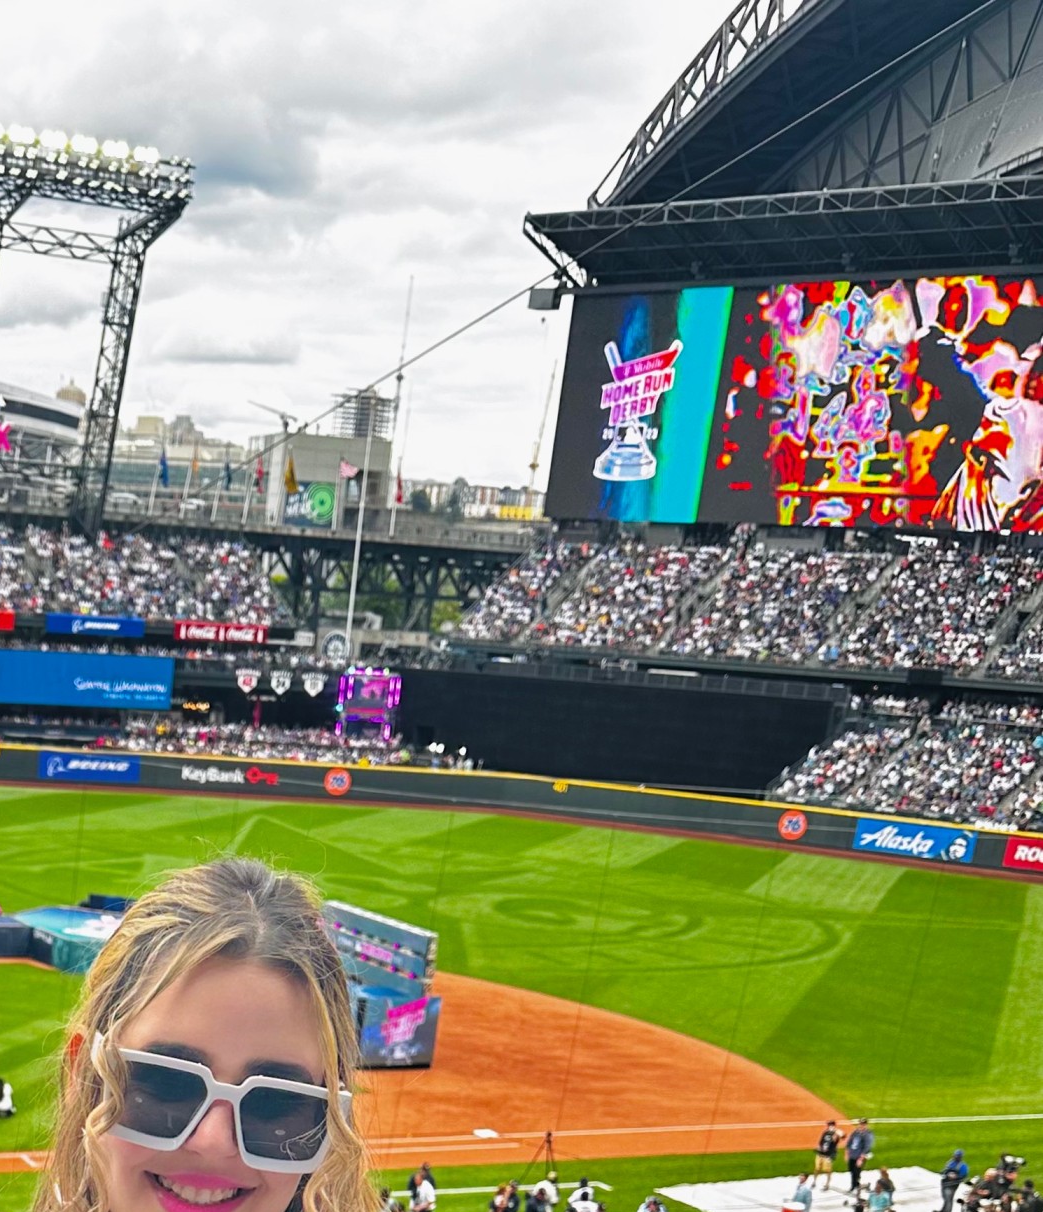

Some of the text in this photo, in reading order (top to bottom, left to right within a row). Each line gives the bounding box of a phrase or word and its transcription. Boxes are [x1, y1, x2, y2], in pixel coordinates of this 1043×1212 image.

[602, 373, 673, 405] HOME RUN
[612, 395, 657, 424] DERBY
[66, 758, 131, 773] BOEING
[181, 764, 245, 785] KeyBank
[329, 774, 347, 789] 76
[783, 817, 802, 833] 76
[860, 825, 935, 856] Alaska
